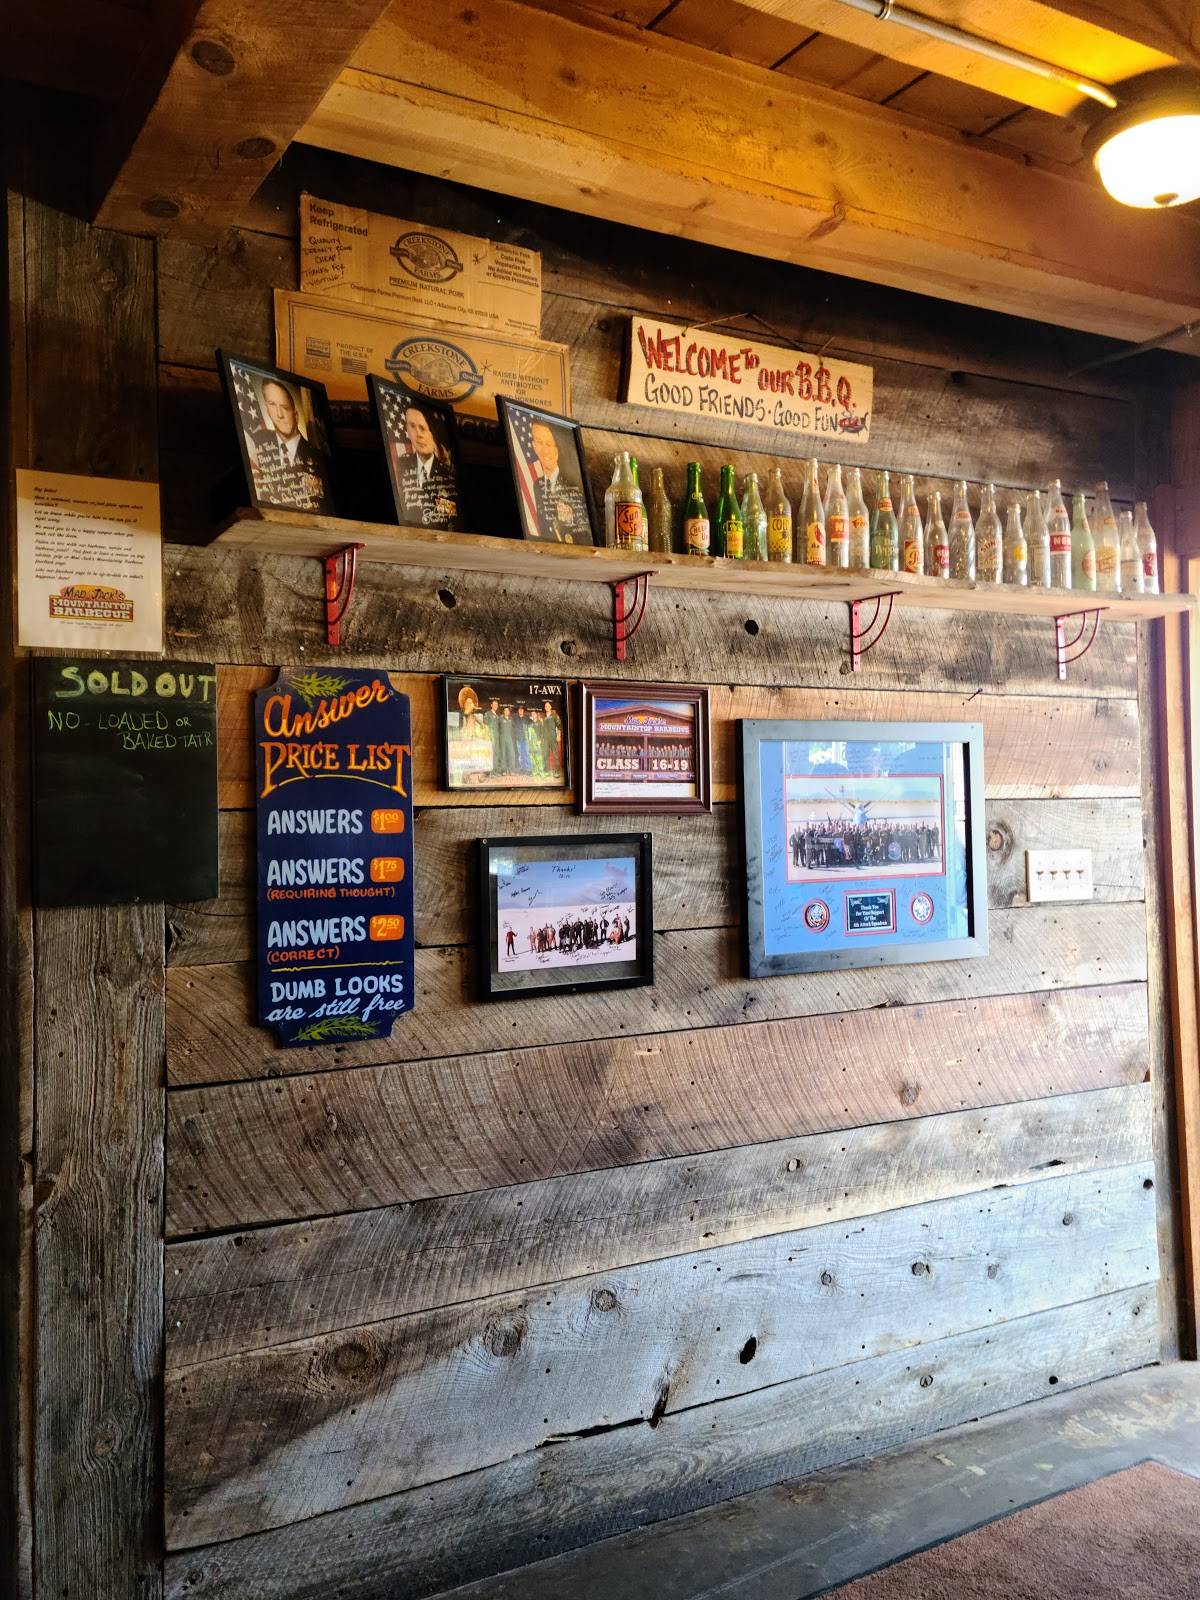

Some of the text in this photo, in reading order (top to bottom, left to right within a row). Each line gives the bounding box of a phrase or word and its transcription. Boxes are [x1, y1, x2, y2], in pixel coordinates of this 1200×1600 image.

[309, 203, 334, 217] Keep
[309, 216, 368, 237] Refrigerated
[413, 267, 442, 279] FARMS
[492, 272, 511, 281] Growth
[496, 267, 512, 276] Added
[391, 276, 465, 299] PREMIUM NATURAL PORK
[336, 342, 365, 352] PRODUCT
[339, 349, 351, 357] THE
[402, 343, 467, 369] CREEKSTONE
[637, 324, 742, 385] WELCOME
[757, 366, 795, 397] OUR
[492, 369, 550, 385] RAISED WITHOUT
[500, 379, 542, 391] ANTIBIOTICS
[416, 383, 455, 398] FARMS
[515, 388, 527, 396] OR
[644, 372, 838, 433] GOOD FRIENDS GOOD FUN
[53, 598, 133, 610] MOUNTAINTOP
[54, 607, 130, 618] BARBECUE
[55, 666, 217, 702] SOLD OUT
[528, 684, 563, 696] 17-AWX
[263, 679, 390, 738] Answer
[48, 710, 193, 732] NO LOADED OR
[122, 731, 177, 750] BAKED
[258, 741, 412, 798] PRICE LIST
[596, 758, 689, 771] CLASS 16-19
[267, 808, 364, 836] ANSWERS
[266, 857, 365, 887] ANSWERS
[266, 886, 396, 902] (REQUIRING THOUGHT)
[267, 915, 367, 948] ANSWERS
[266, 945, 341, 964] (CORRECT)
[269, 973, 404, 1003] DUMB LOOKS
[264, 994, 406, 1023] are still free
